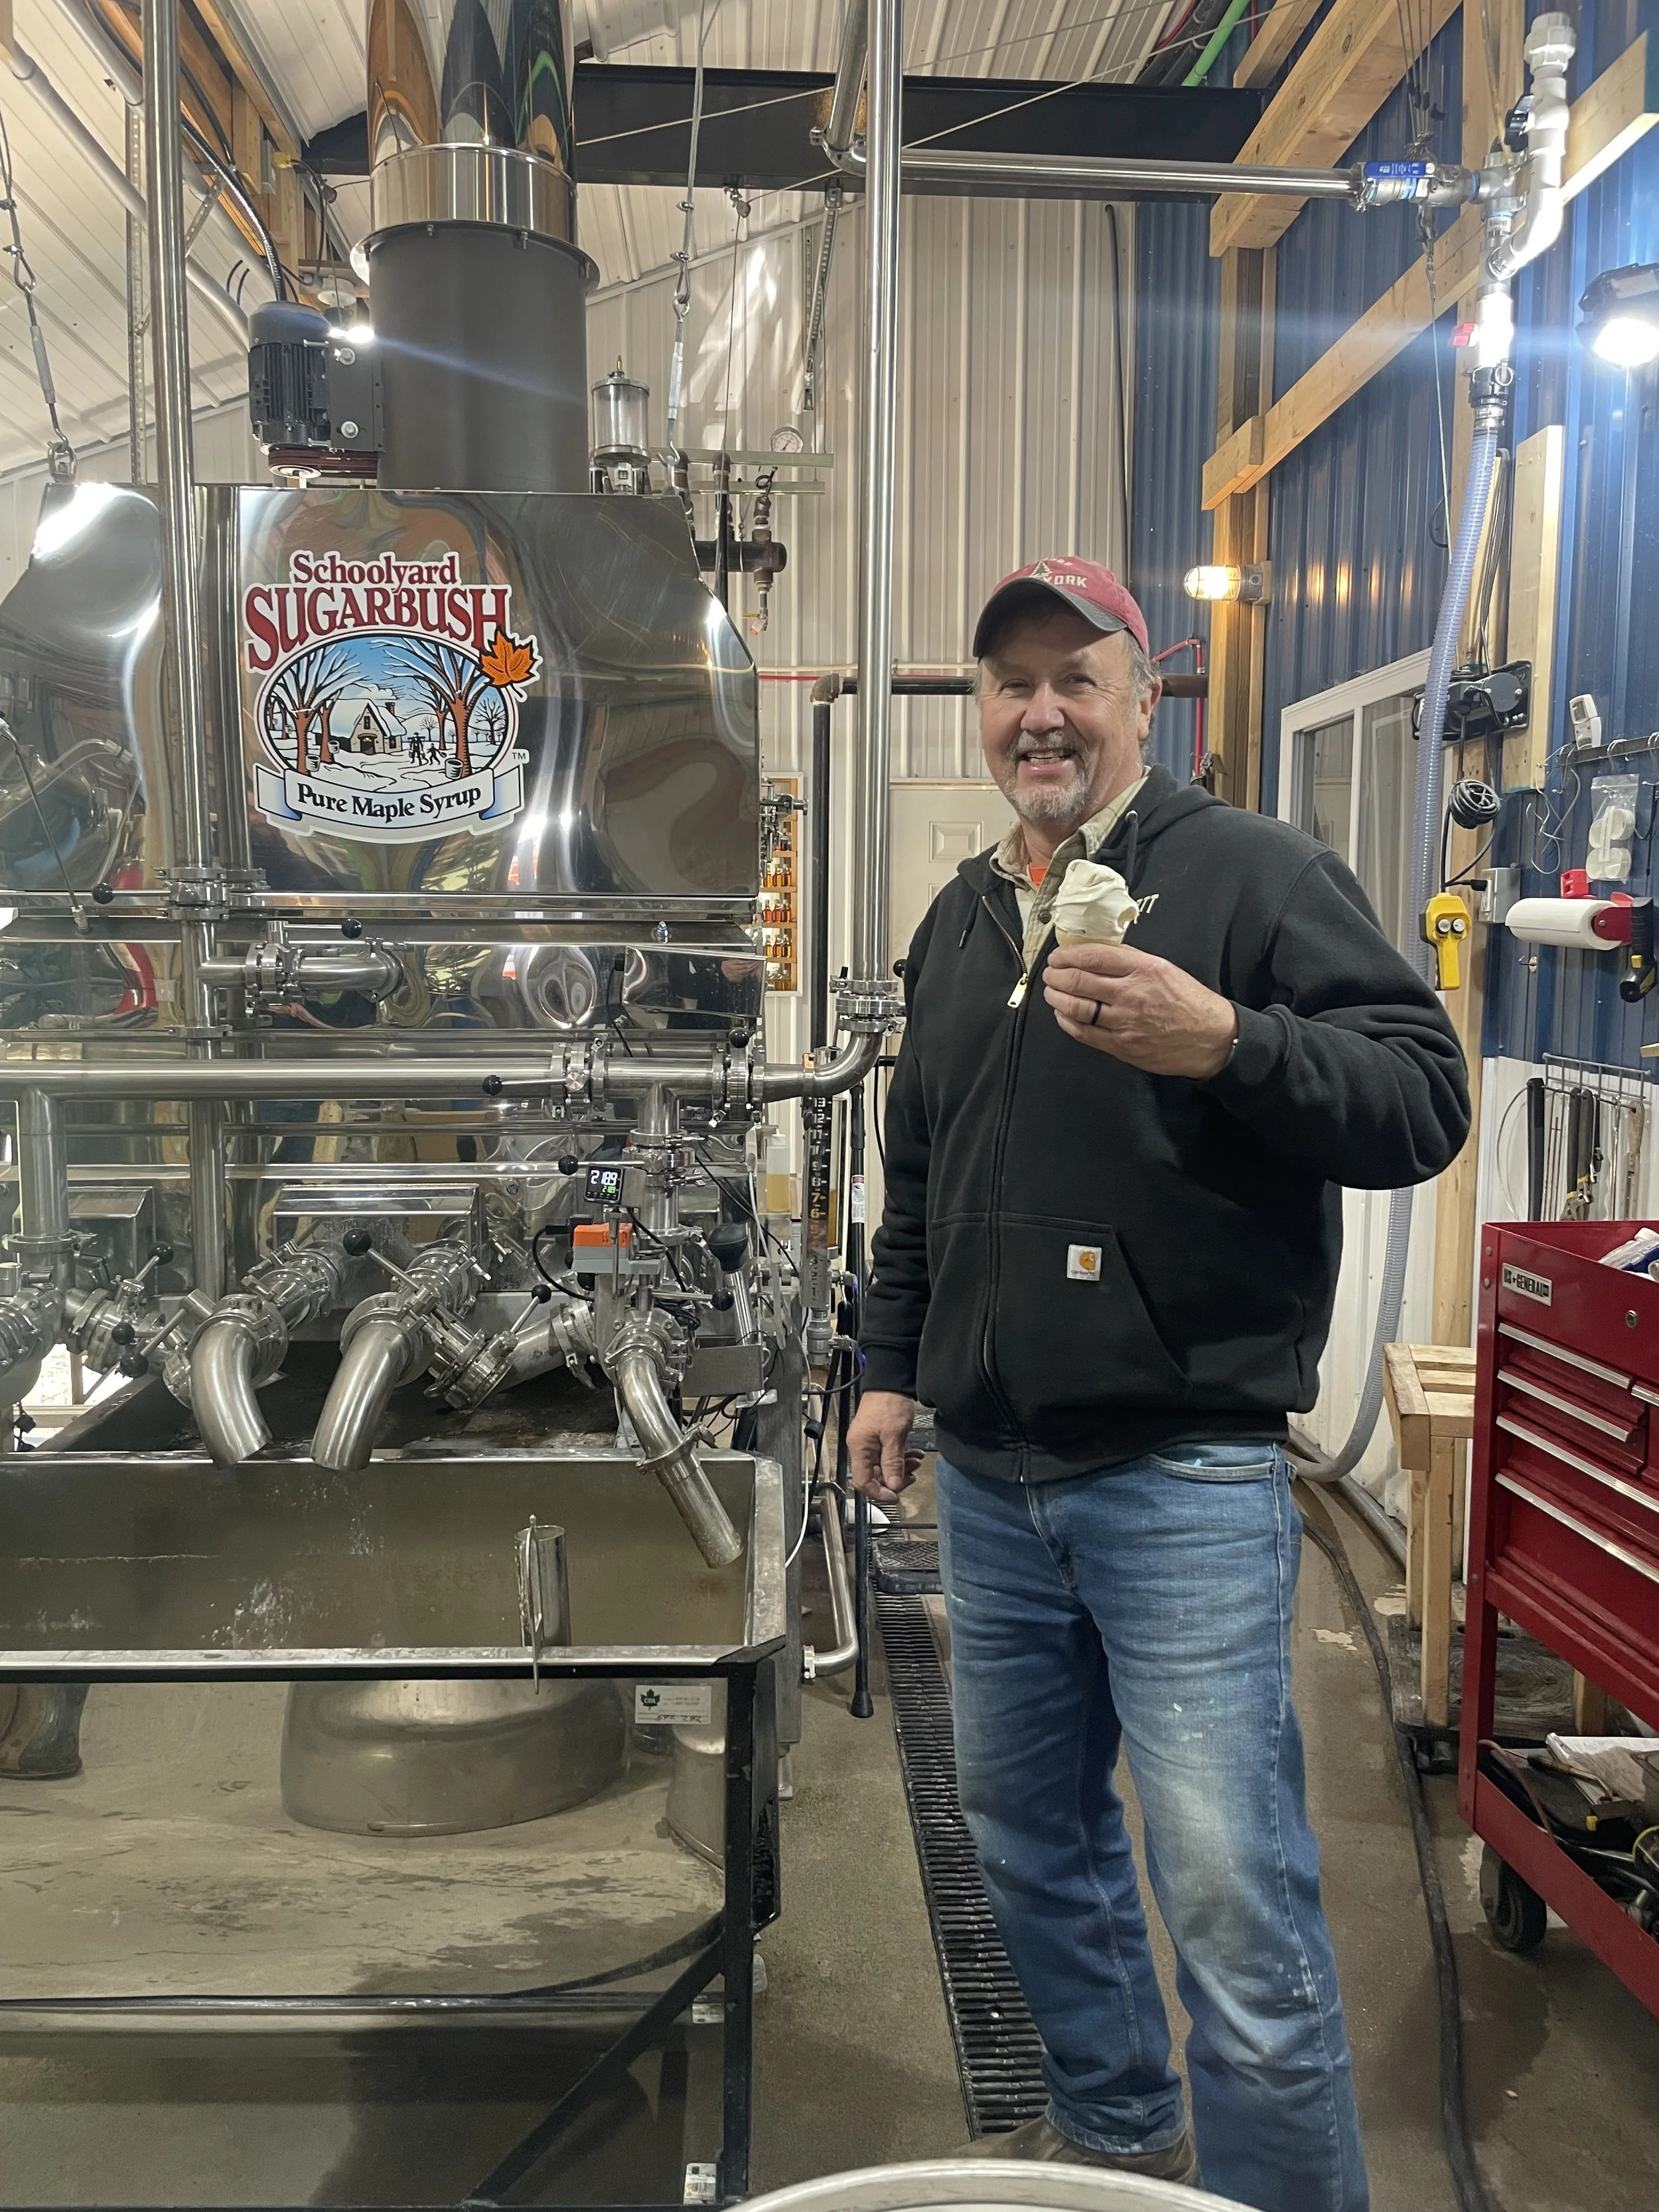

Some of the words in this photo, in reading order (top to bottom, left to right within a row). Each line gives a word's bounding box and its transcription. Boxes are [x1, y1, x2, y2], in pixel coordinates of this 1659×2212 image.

[293, 553, 457, 595] Schoolyard
[246, 586, 508, 670] SUGARBUSH
[512, 752, 526, 761] TM
[297, 783, 347, 813] Pure
[352, 796, 416, 824] Maple
[420, 786, 482, 820] Syrup
[812, 1114, 825, 1123] 12
[810, 1129, 822, 1139] 11
[812, 1177, 821, 1187] 8
[811, 1192, 820, 1203] 7
[810, 1208, 820, 1218] 6
[1504, 1268, 1512, 1284] US
[1517, 1274, 1544, 1297] GENERAL
